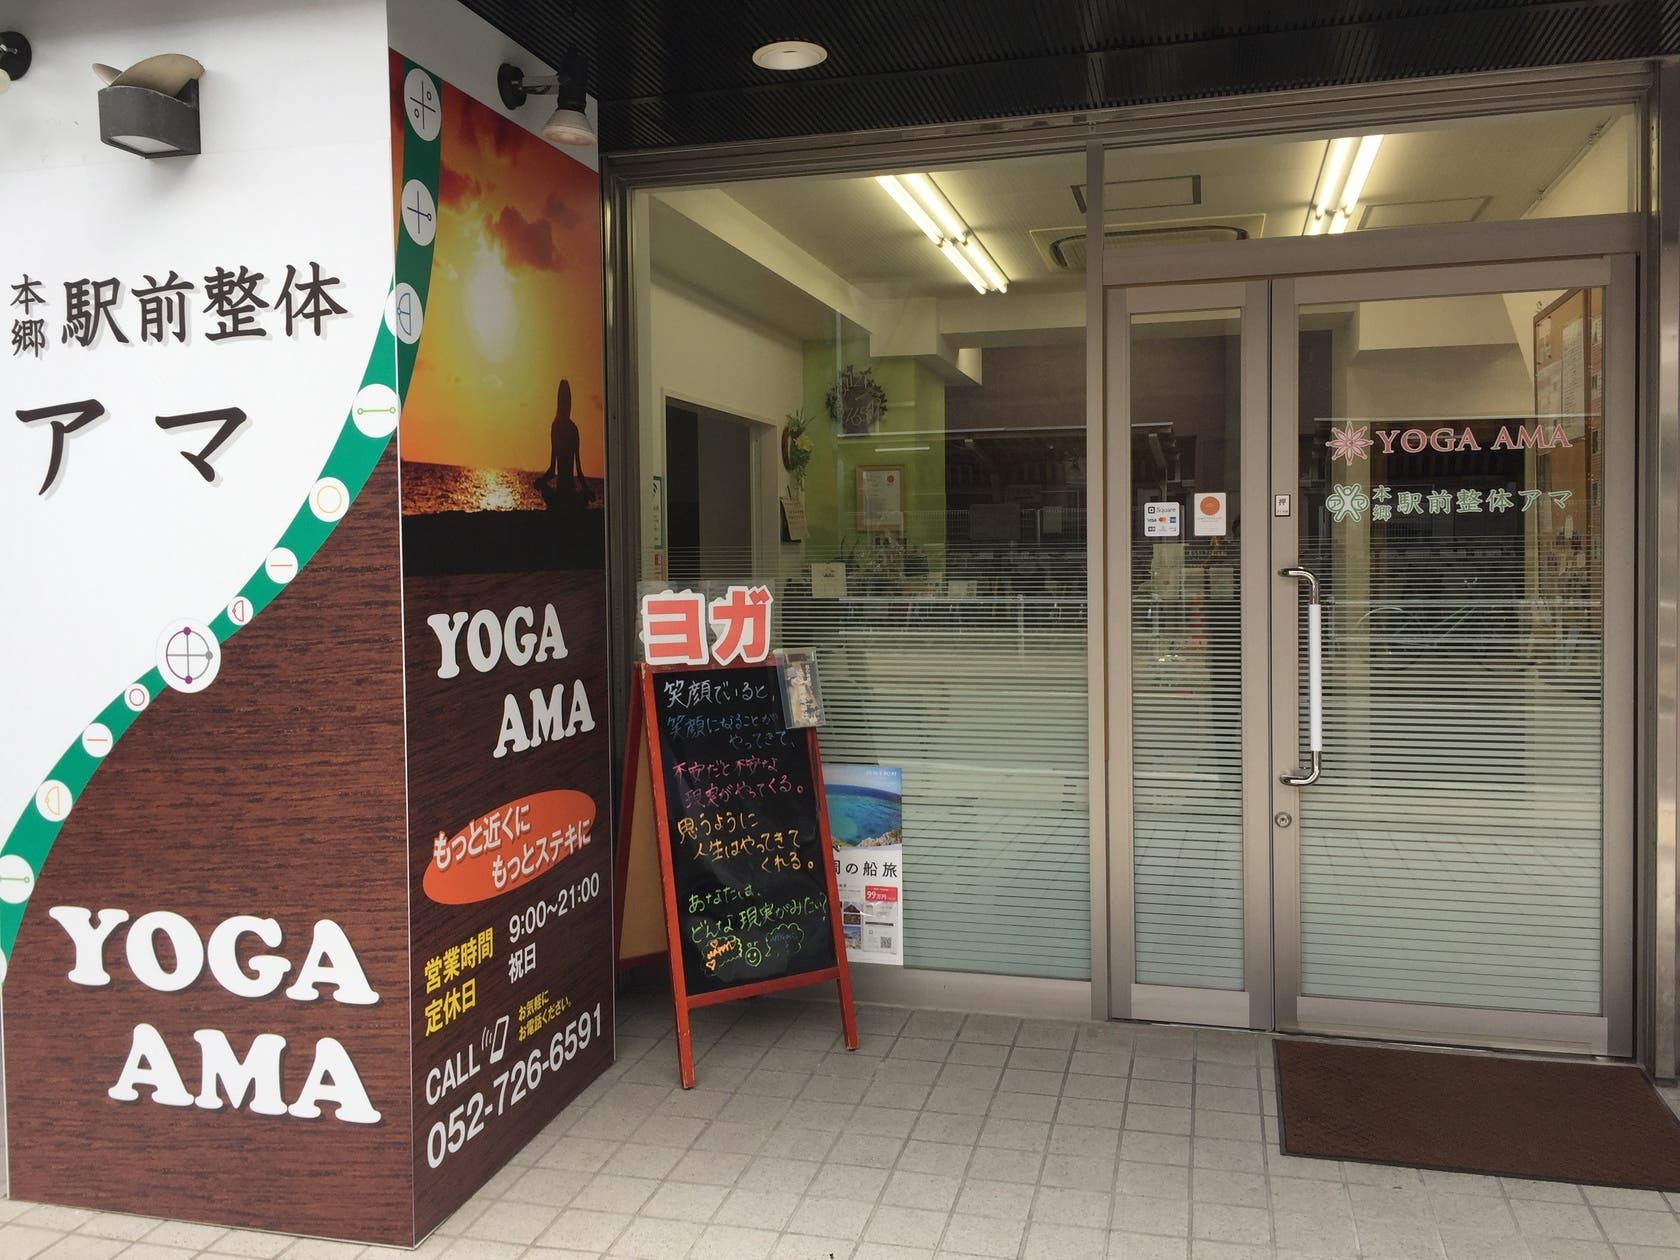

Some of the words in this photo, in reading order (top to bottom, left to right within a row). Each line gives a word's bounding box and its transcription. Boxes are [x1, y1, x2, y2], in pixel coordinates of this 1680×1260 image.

[10, 273, 46, 358] 本郷
[61, 261, 348, 347] 駅前整体
[15, 398, 247, 495] アマ
[1375, 424, 1482, 454] YOGA
[1489, 423, 1573, 450] AMA
[1396, 488, 1573, 515] 駅前整体アマ
[426, 603, 568, 679] YOGA
[639, 585, 774, 666] ヨガ
[492, 679, 595, 759] AMA
[433, 803, 531, 872] もっと近くに
[491, 818, 592, 890] もっとステキに
[48, 906, 381, 1005] YOGA
[424, 927, 494, 995] 営業時間
[424, 977, 476, 1037] 定休日
[508, 942, 537, 985] 祝日
[107, 1022, 382, 1124] AMA
[425, 1043, 481, 1106] CALL
[426, 1002, 602, 1169] 052-726-6591
